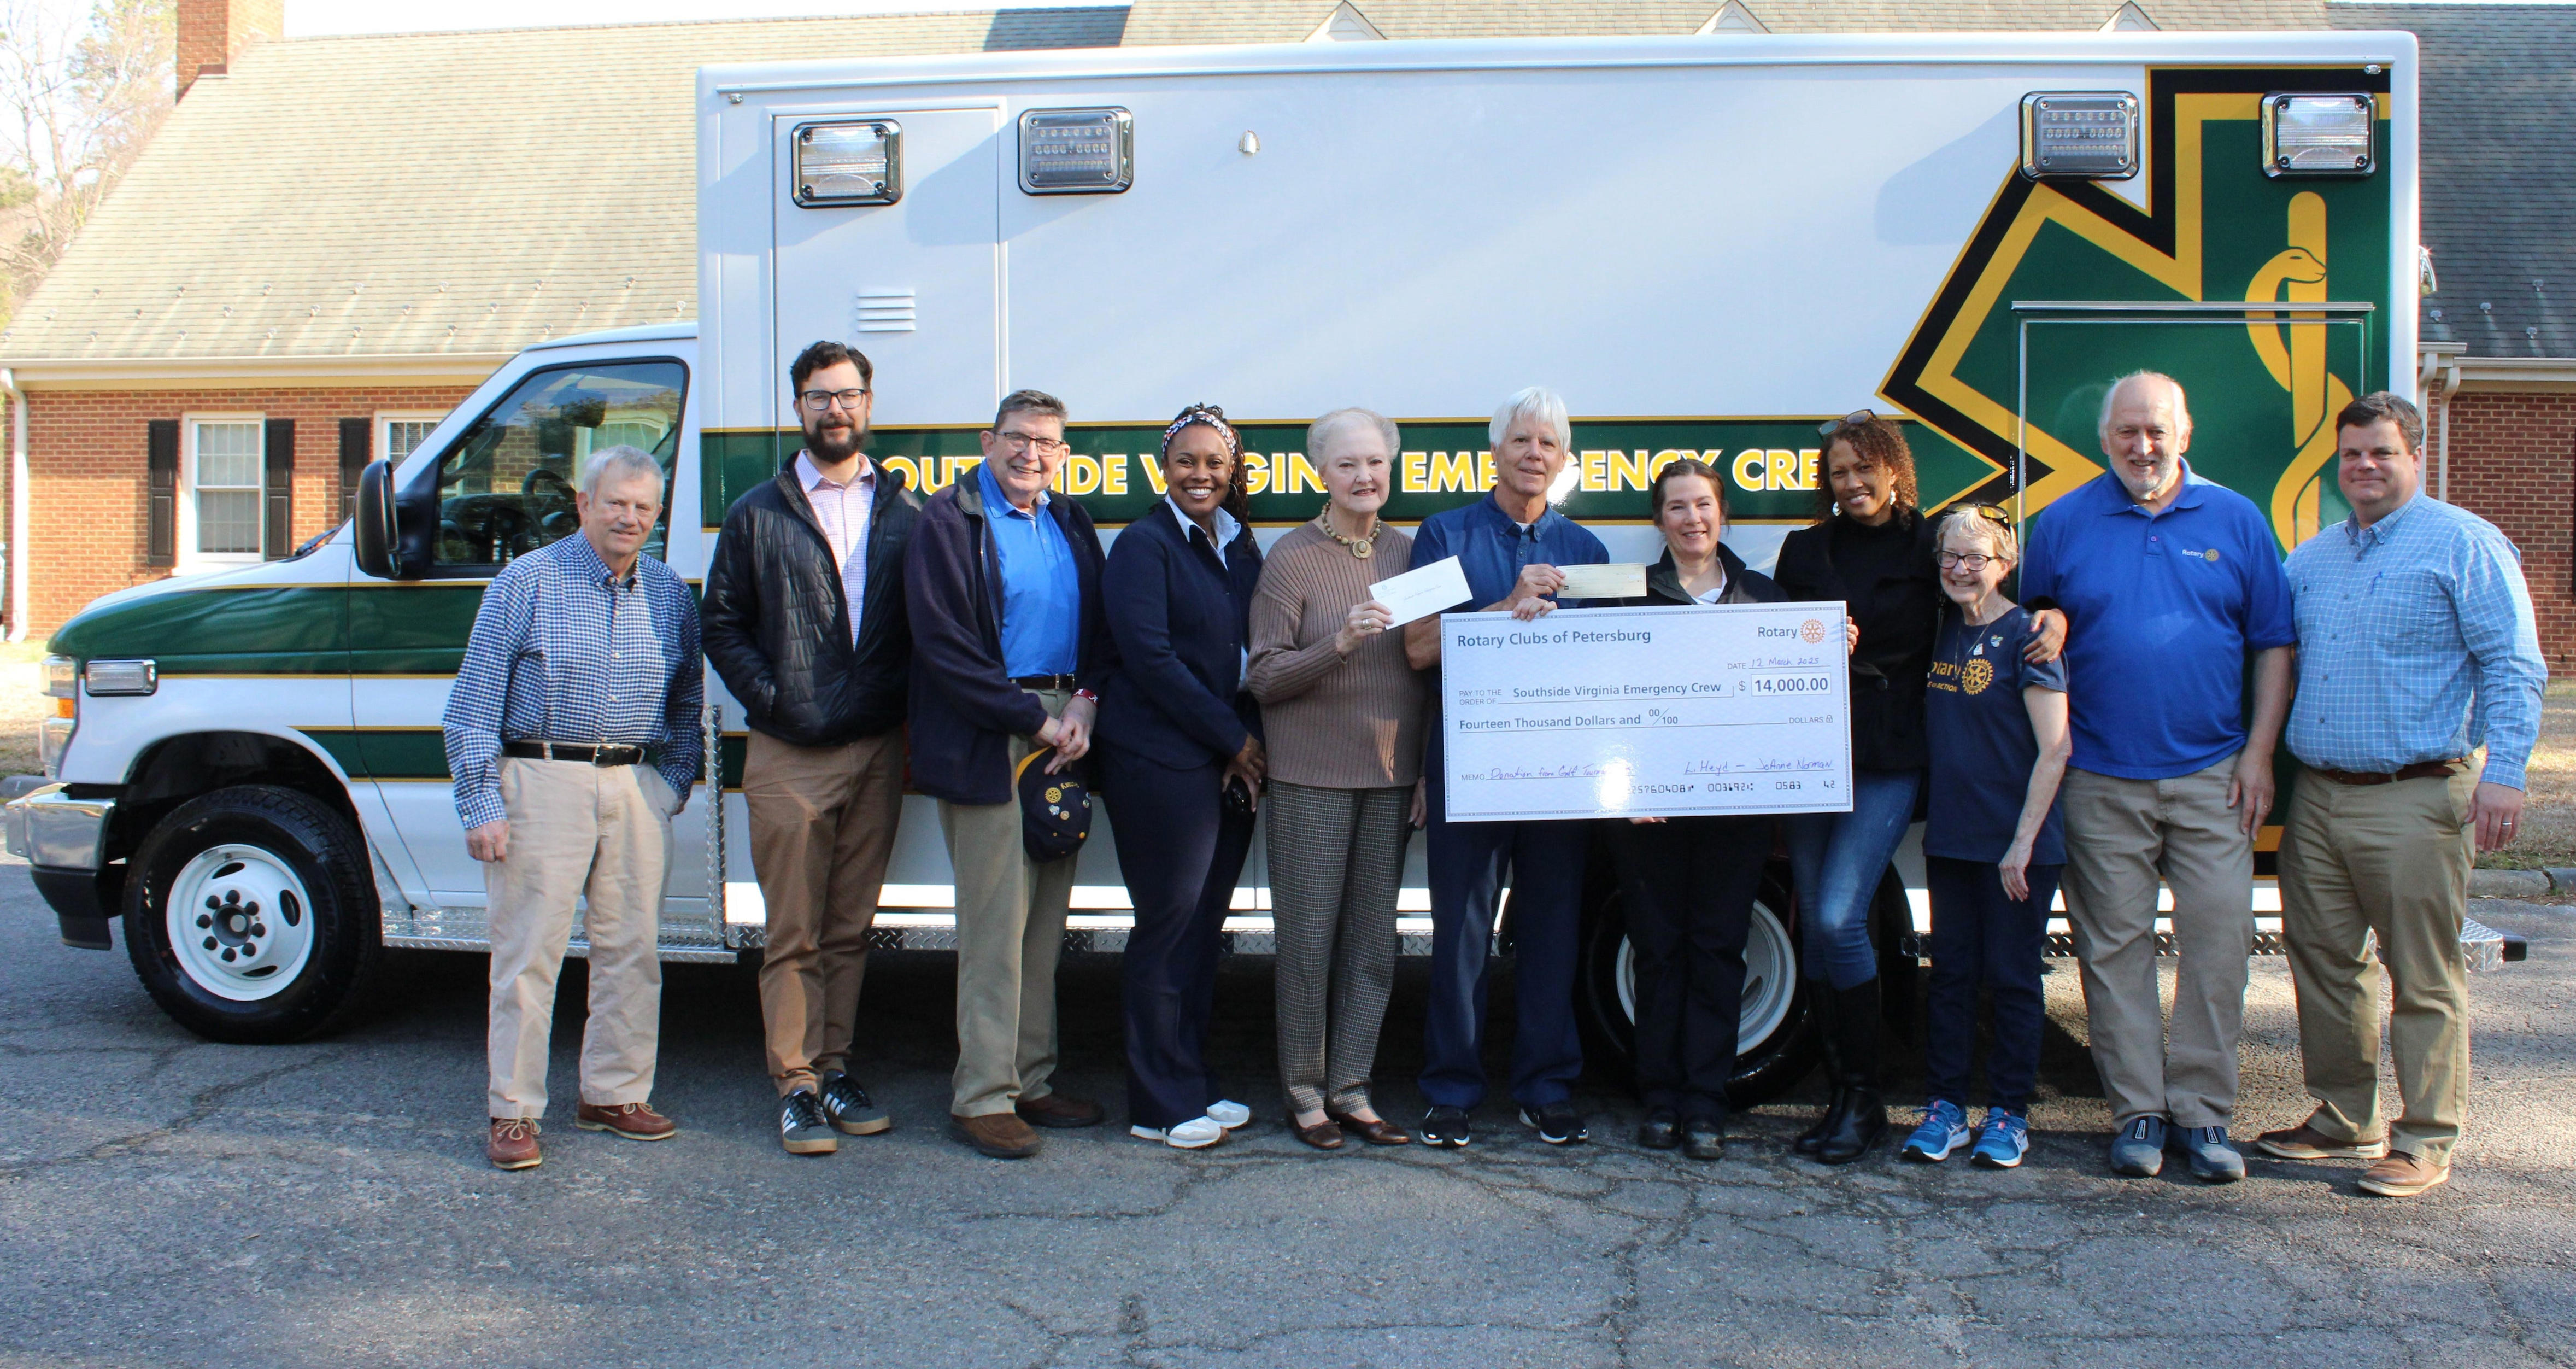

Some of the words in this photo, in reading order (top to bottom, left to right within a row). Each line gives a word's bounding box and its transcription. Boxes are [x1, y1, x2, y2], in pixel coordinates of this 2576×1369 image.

[1139, 452, 1329, 495] VGIN
[1732, 448, 1821, 492] CRE
[2182, 549, 2204, 558] Rotary
[1457, 635, 1505, 648] Rotary
[1509, 632, 1548, 645] Clubs
[1553, 630, 1568, 643] of
[1572, 629, 1651, 644] Petersburg
[1757, 626, 1798, 639] Rotary
[1751, 658, 1764, 668] 12
[1797, 657, 1820, 665] 2025
[1513, 687, 1571, 698] Southside
[1574, 685, 1619, 698] Virginia
[1623, 683, 1687, 697] Emergency
[1691, 682, 1721, 693] Crew
[1738, 680, 1746, 692] $
[1755, 677, 1828, 694] 14,000.00
[1460, 719, 1511, 729] Fourteen
[1515, 716, 1571, 728] Thousand
[1575, 715, 1616, 726] Dollars
[1619, 714, 1640, 724] and
[1539, 767, 1554, 776] from
[1823, 780, 1835, 788] 42
